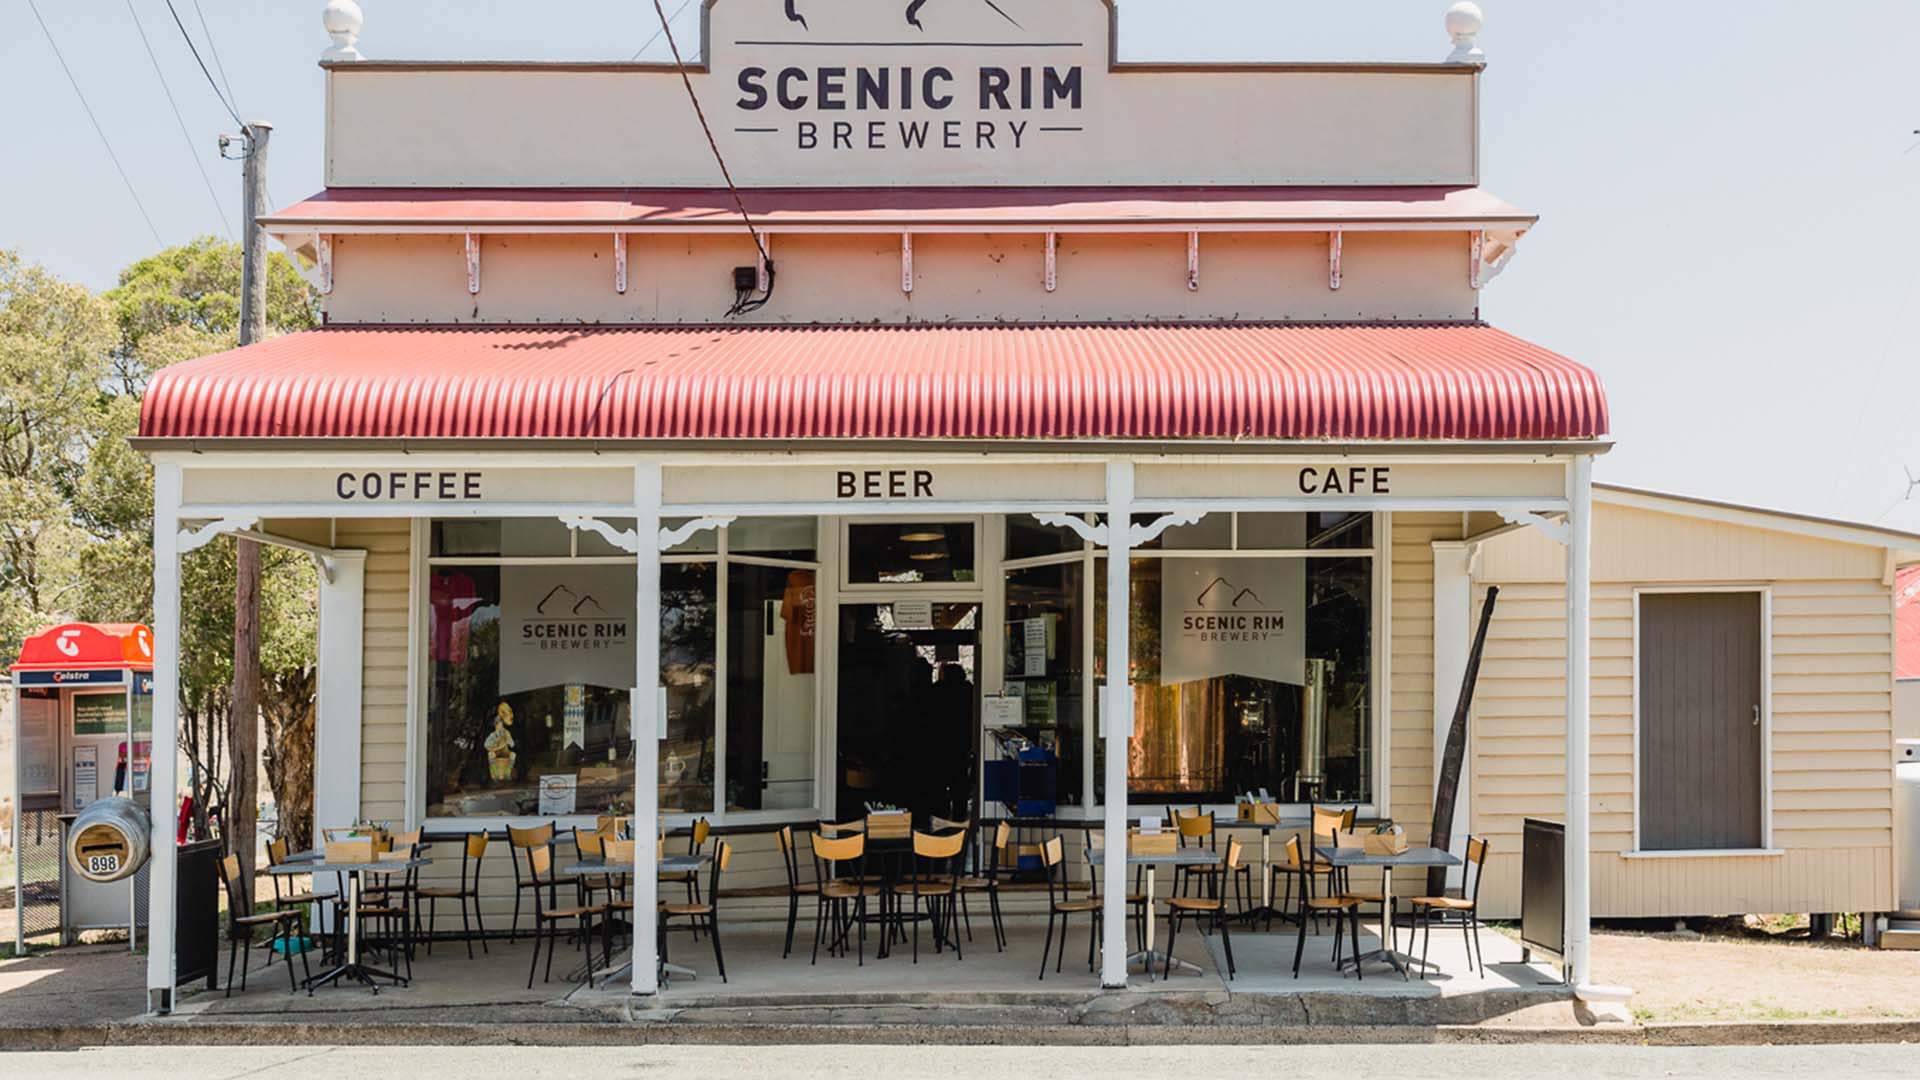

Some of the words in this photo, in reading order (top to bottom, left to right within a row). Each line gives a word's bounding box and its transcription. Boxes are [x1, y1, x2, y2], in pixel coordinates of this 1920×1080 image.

[736, 66, 954, 110] SCENIC
[979, 66, 1083, 110] RIM
[798, 120, 1028, 149] BREWERY
[336, 472, 482, 500] COFFEE
[836, 470, 934, 498] BEER
[1298, 467, 1390, 494] CAFE
[1183, 616, 1247, 629] SCENIC
[1253, 616, 1284, 629] RIM
[522, 623, 588, 639] SCENIC
[594, 623, 627, 638] RIM
[1201, 632, 1268, 641] BREWERY
[540, 639, 611, 649] BREWERY
[53, 671, 89, 683] Telstra
[91, 855, 117, 871] 898
